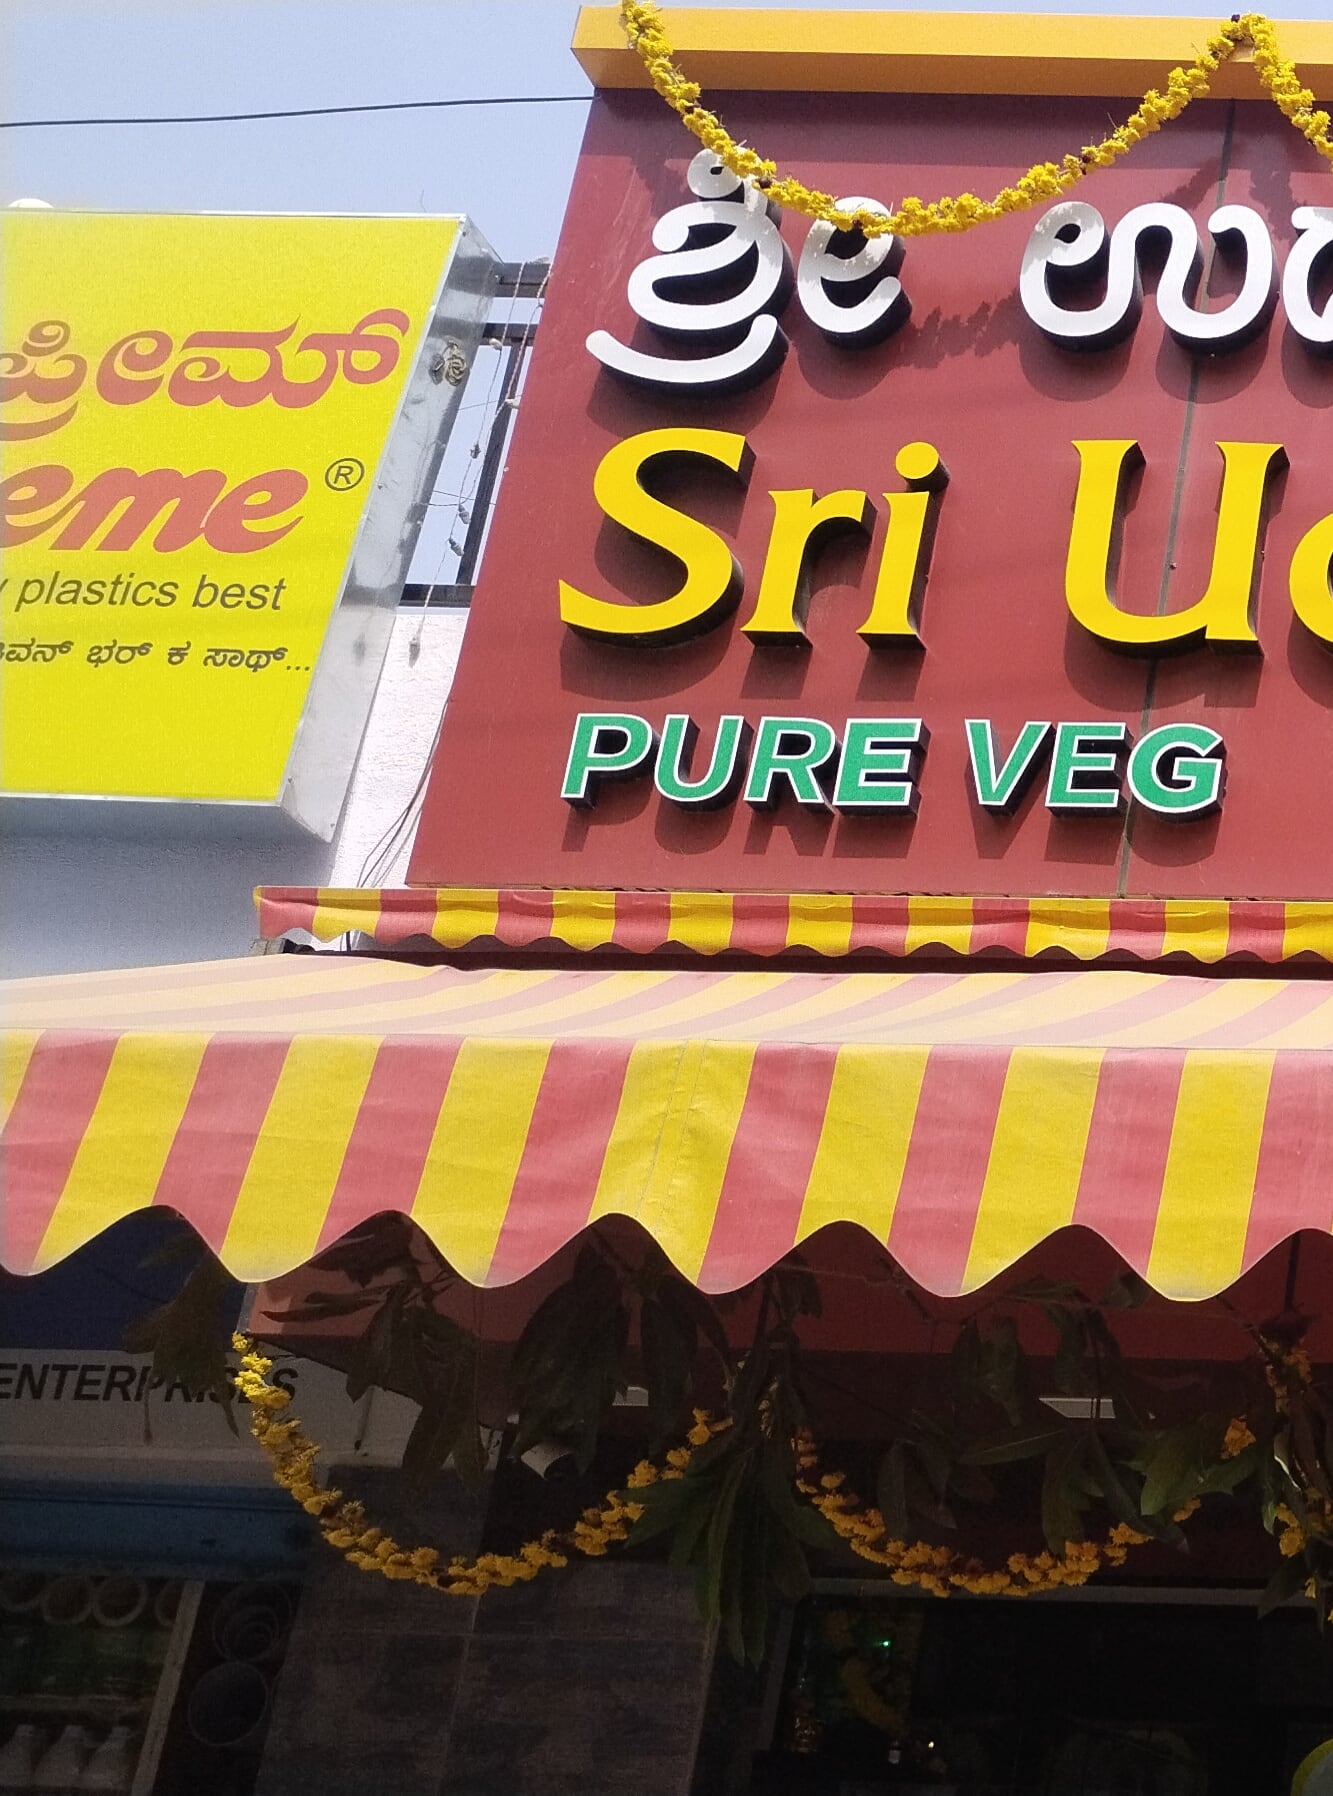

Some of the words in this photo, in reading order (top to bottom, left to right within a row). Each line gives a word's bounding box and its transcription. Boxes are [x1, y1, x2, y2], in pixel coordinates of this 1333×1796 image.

[585, 147, 902, 384] ಶ್ರೀ
[15, 571, 180, 612] plastics
[192, 574, 288, 612] best
[559, 427, 941, 635] Sri
[560, 712, 923, 807] PURE
[964, 718, 1225, 814] VEG
